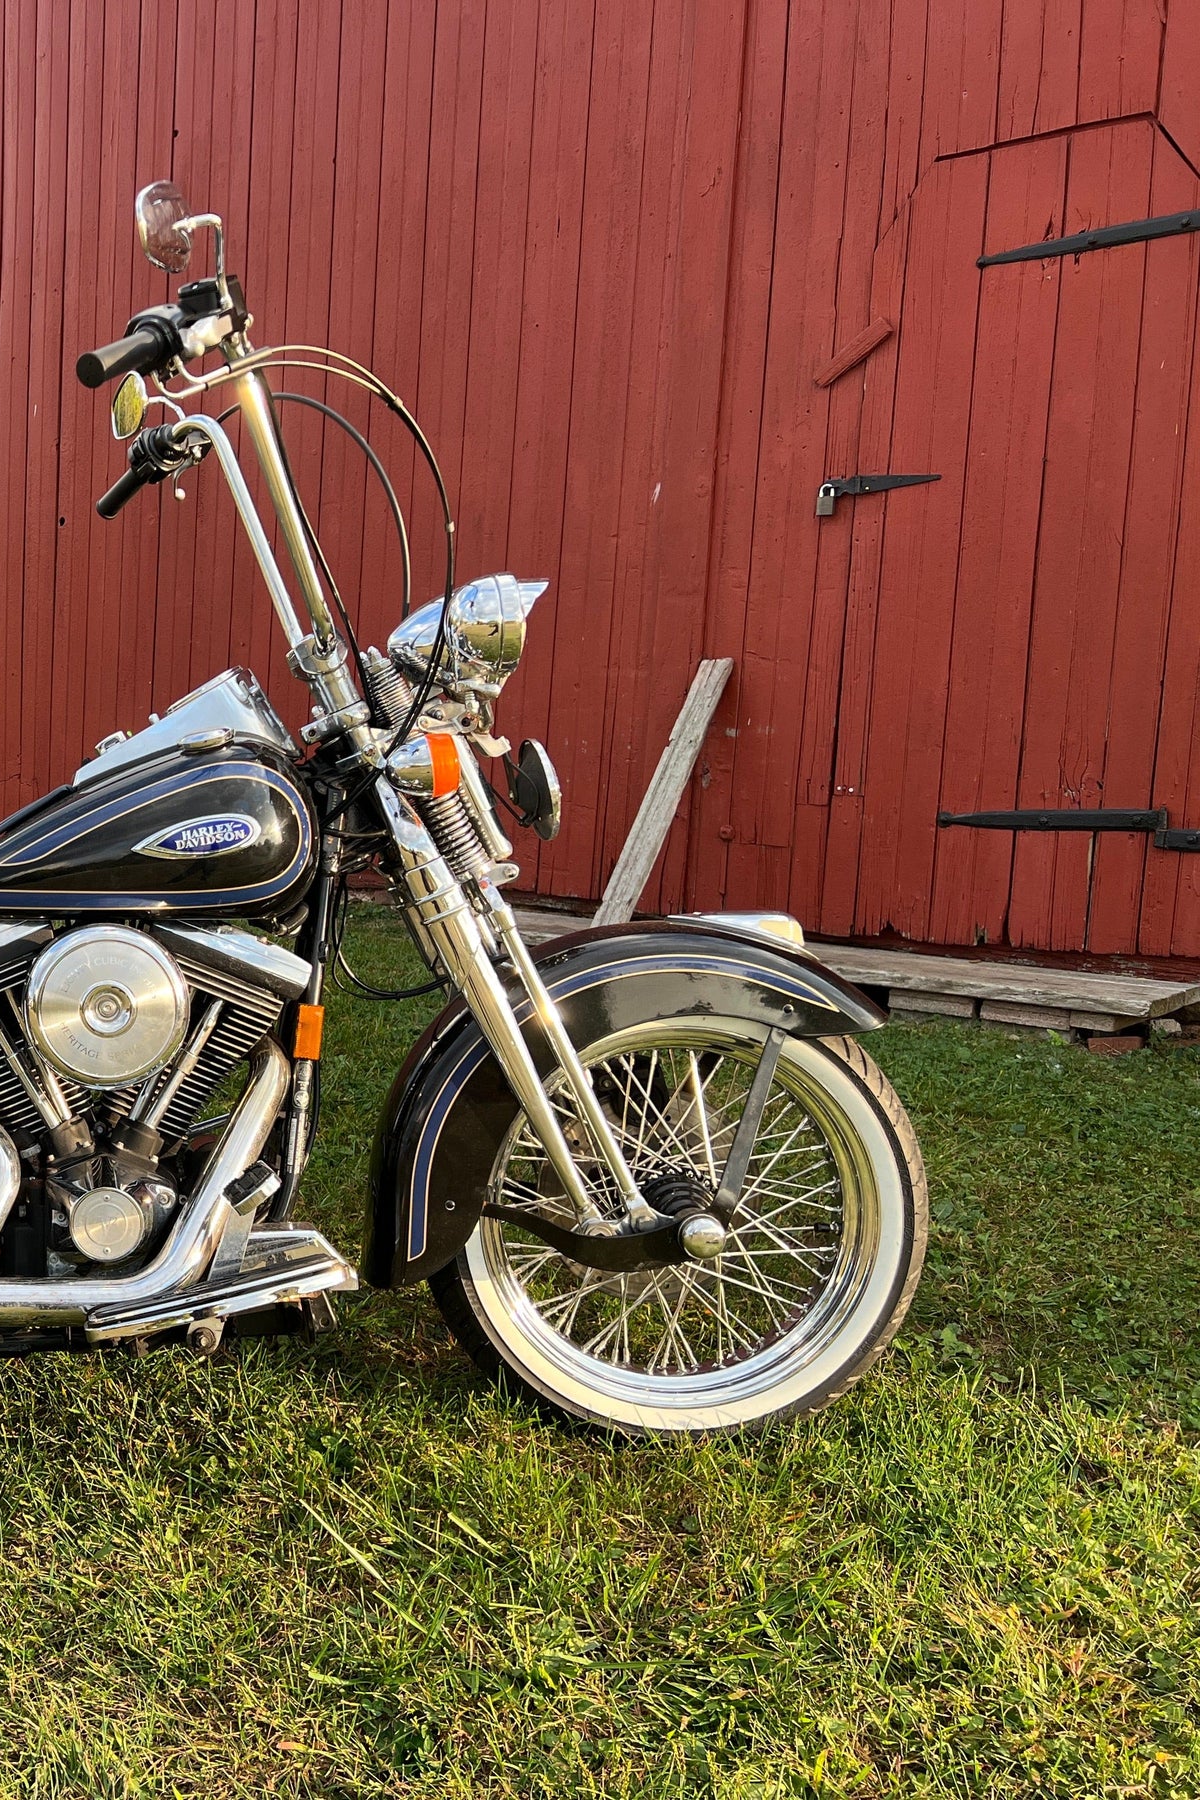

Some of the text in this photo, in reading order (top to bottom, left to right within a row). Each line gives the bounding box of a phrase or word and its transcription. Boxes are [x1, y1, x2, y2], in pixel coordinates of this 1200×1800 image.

[174, 829, 246, 850] DAVIDSON
[181, 822, 242, 840] HARLEY-
[94, 956, 129, 967] CUBIC
[60, 1022, 101, 1059] HERITAGE
